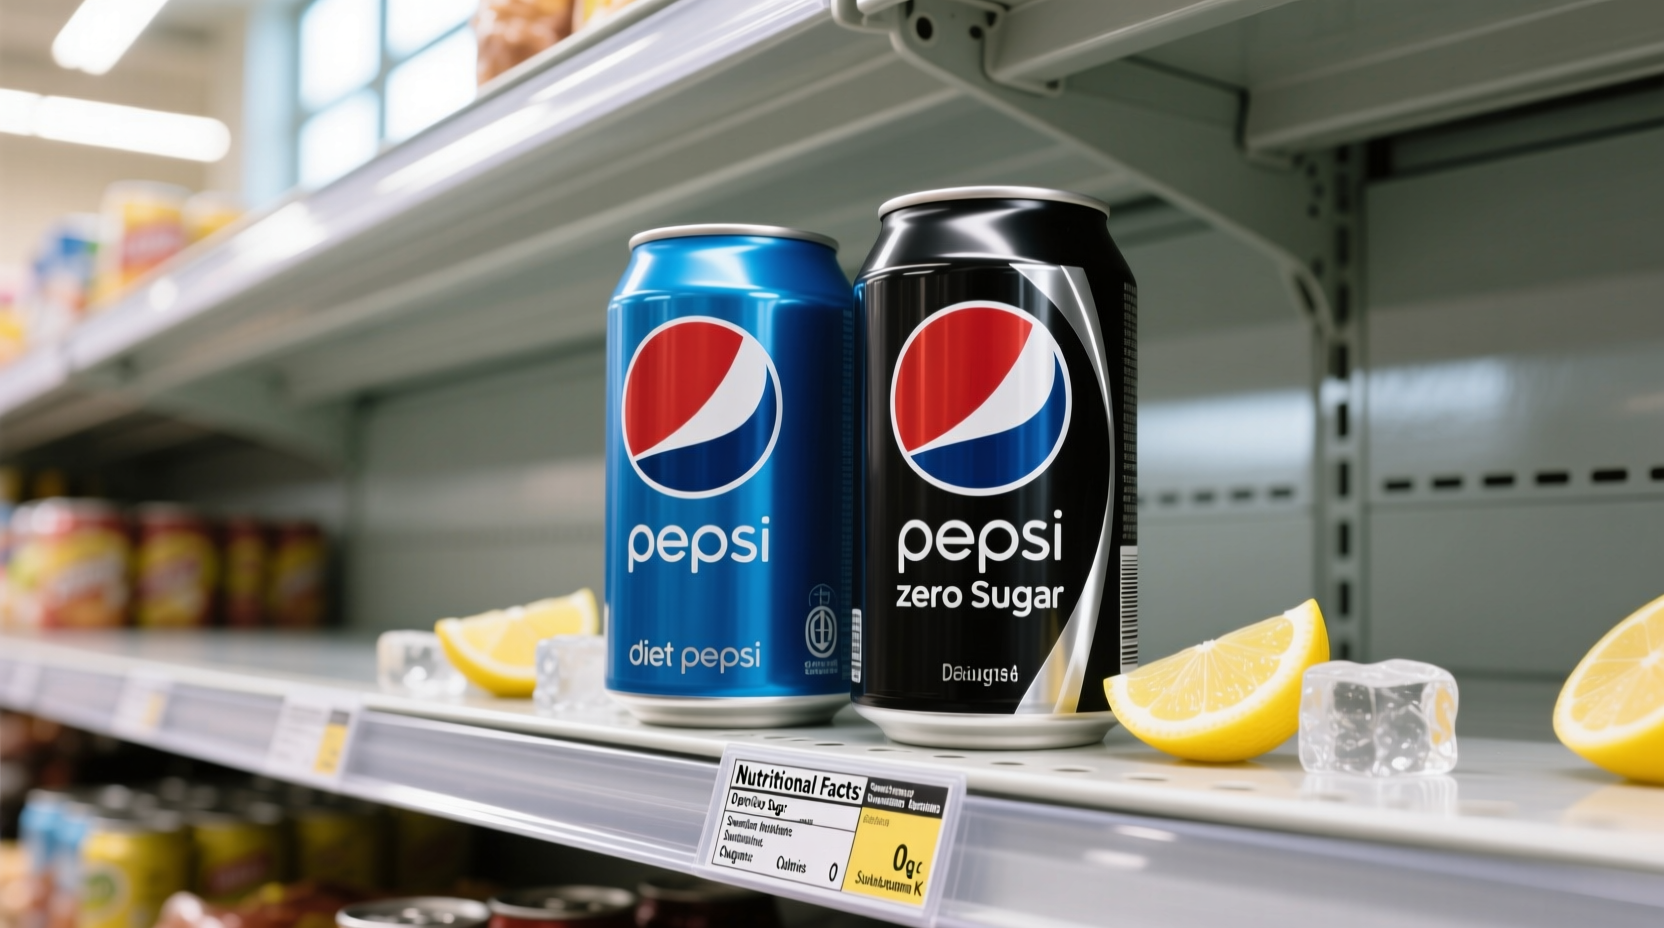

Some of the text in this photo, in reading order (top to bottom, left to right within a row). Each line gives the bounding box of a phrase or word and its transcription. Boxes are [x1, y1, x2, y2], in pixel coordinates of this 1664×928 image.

[628, 516, 770, 574] pepsi
[898, 509, 1063, 574] pepsi
[896, 580, 1064, 618] zero Sugar
[629, 639, 761, 674] diet pepsi
[735, 764, 817, 796] Nutritional
[820, 776, 861, 801] Facts
[828, 862, 838, 882] 0
